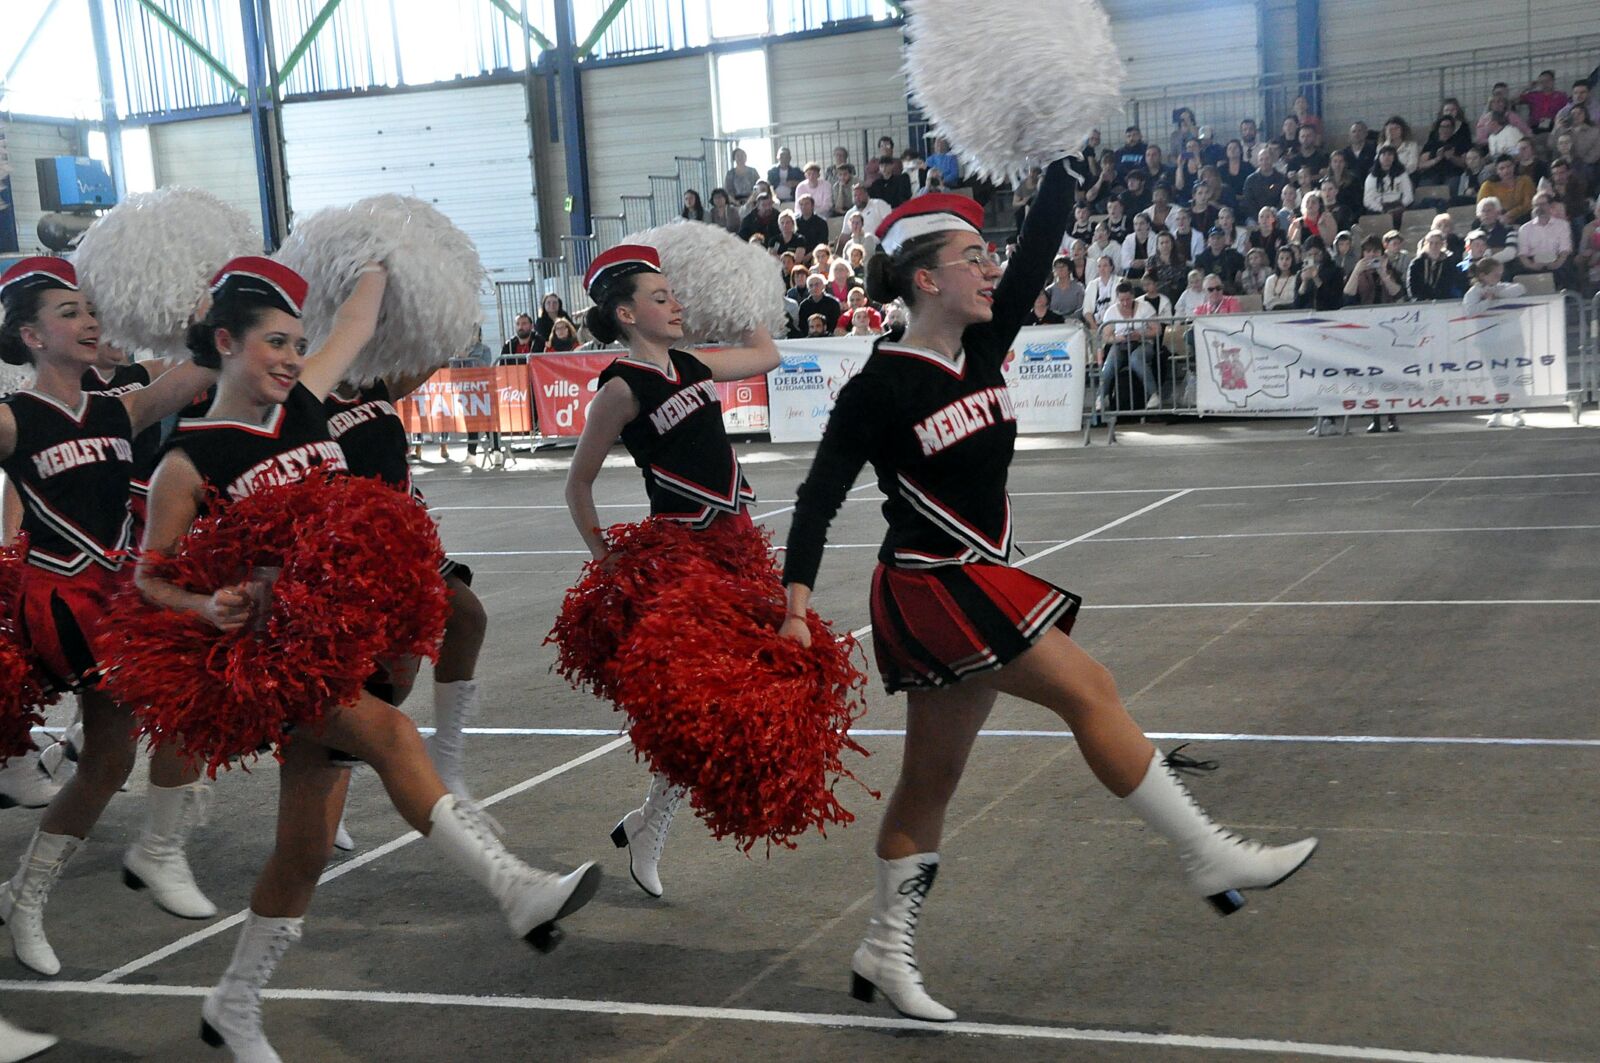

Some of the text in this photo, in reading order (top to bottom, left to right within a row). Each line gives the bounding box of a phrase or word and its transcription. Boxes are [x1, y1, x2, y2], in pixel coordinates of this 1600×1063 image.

[1019, 363, 1073, 375] DEBARD
[1300, 354, 1555, 378] NORD GIRONDE
[411, 381, 490, 394] ARTEMENT
[544, 380, 579, 398] ville
[774, 375, 824, 386] DEBARD
[411, 393, 492, 417] TARN
[1342, 393, 1510, 410] ESTUAIRE
